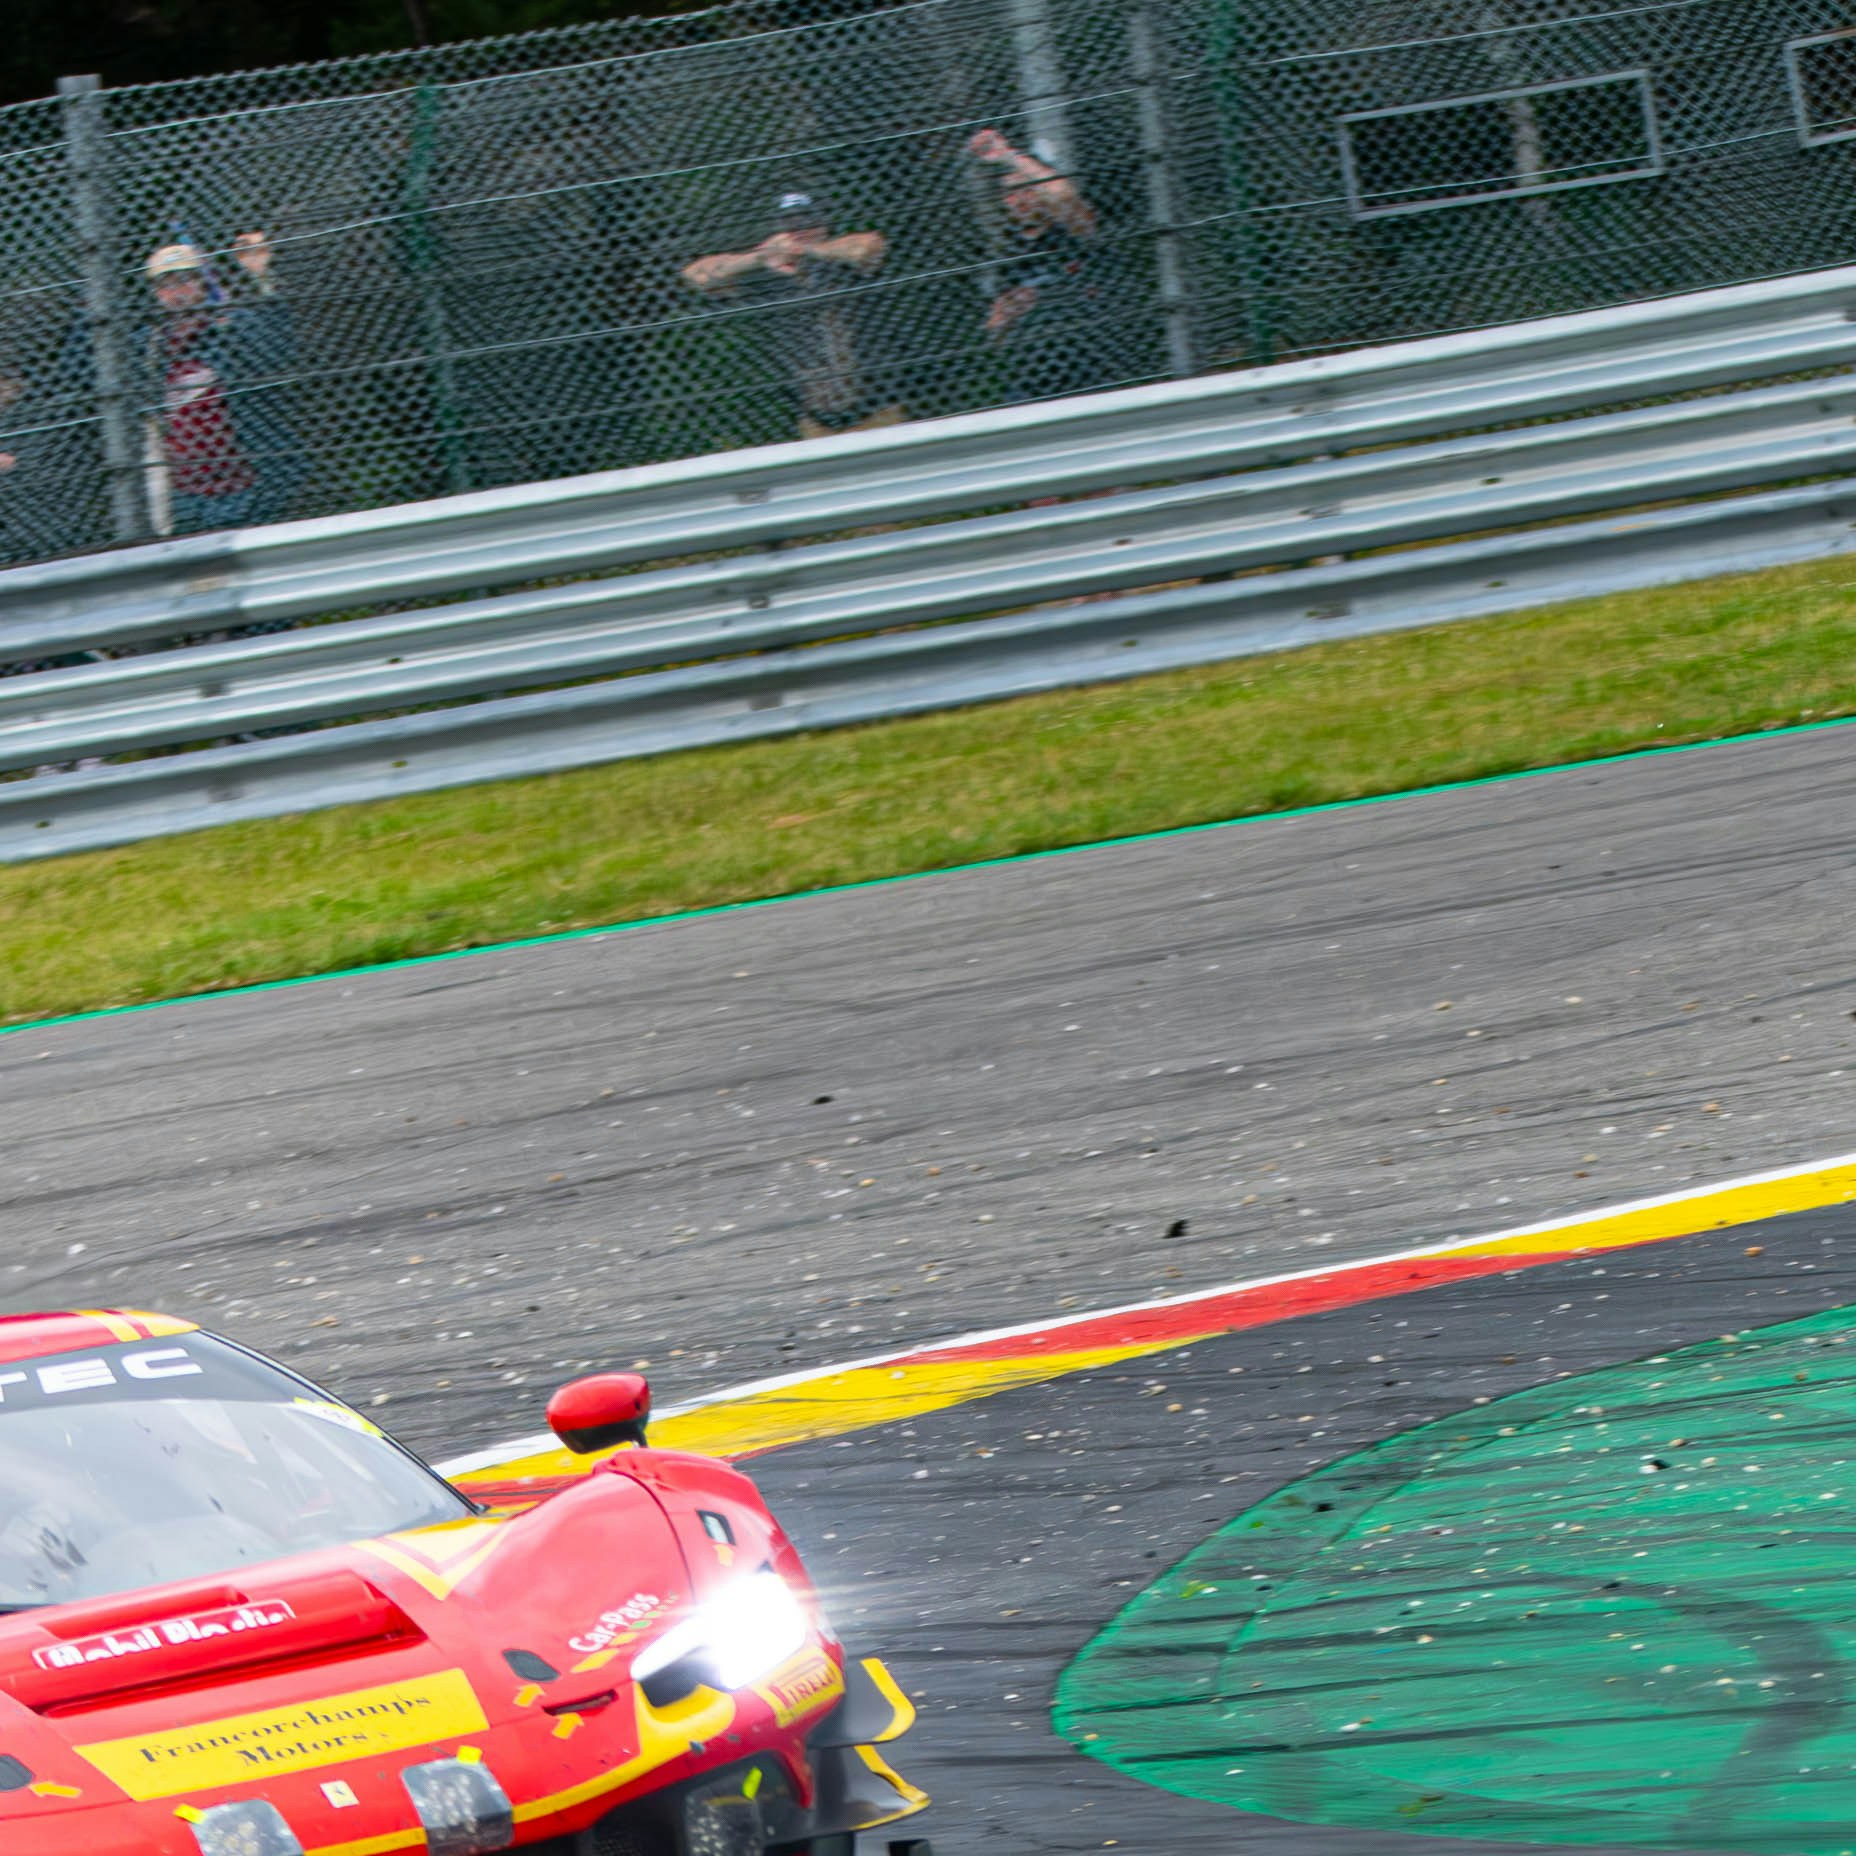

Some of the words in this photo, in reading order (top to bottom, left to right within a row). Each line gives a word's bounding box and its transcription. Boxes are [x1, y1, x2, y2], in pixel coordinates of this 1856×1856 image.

[567, 1592, 660, 1652] Car-Pass
[139, 1693, 432, 1763] Francorchamps
[235, 1731, 369, 1767] Motors
